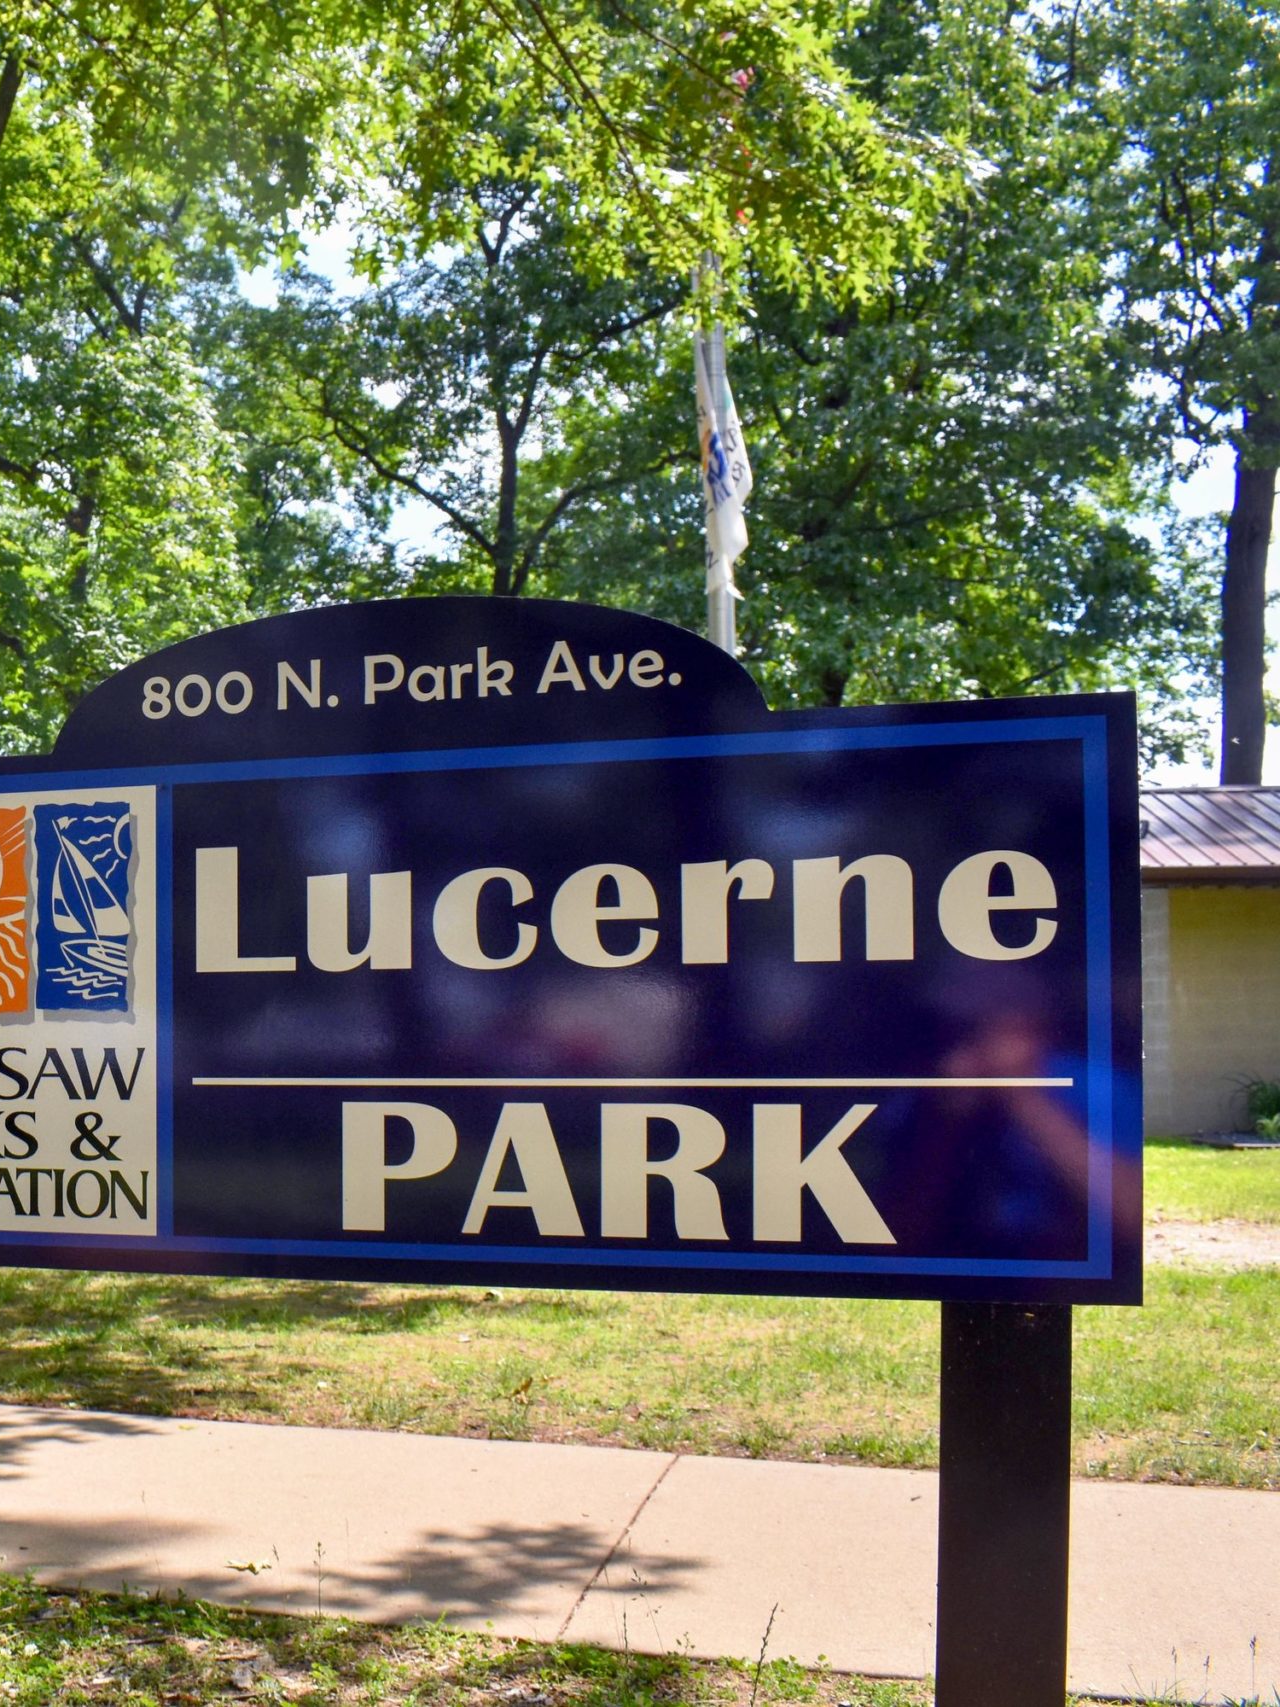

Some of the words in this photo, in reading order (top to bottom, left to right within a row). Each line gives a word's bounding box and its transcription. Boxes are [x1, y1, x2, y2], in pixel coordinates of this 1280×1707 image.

[140, 671, 253, 720] 800
[277, 659, 339, 711] N.
[364, 646, 514, 705] Park
[536, 640, 681, 694] Ave.
[195, 846, 1058, 973] Lucerne
[69, 1111, 122, 1162] &
[342, 1101, 898, 1244] PARK
